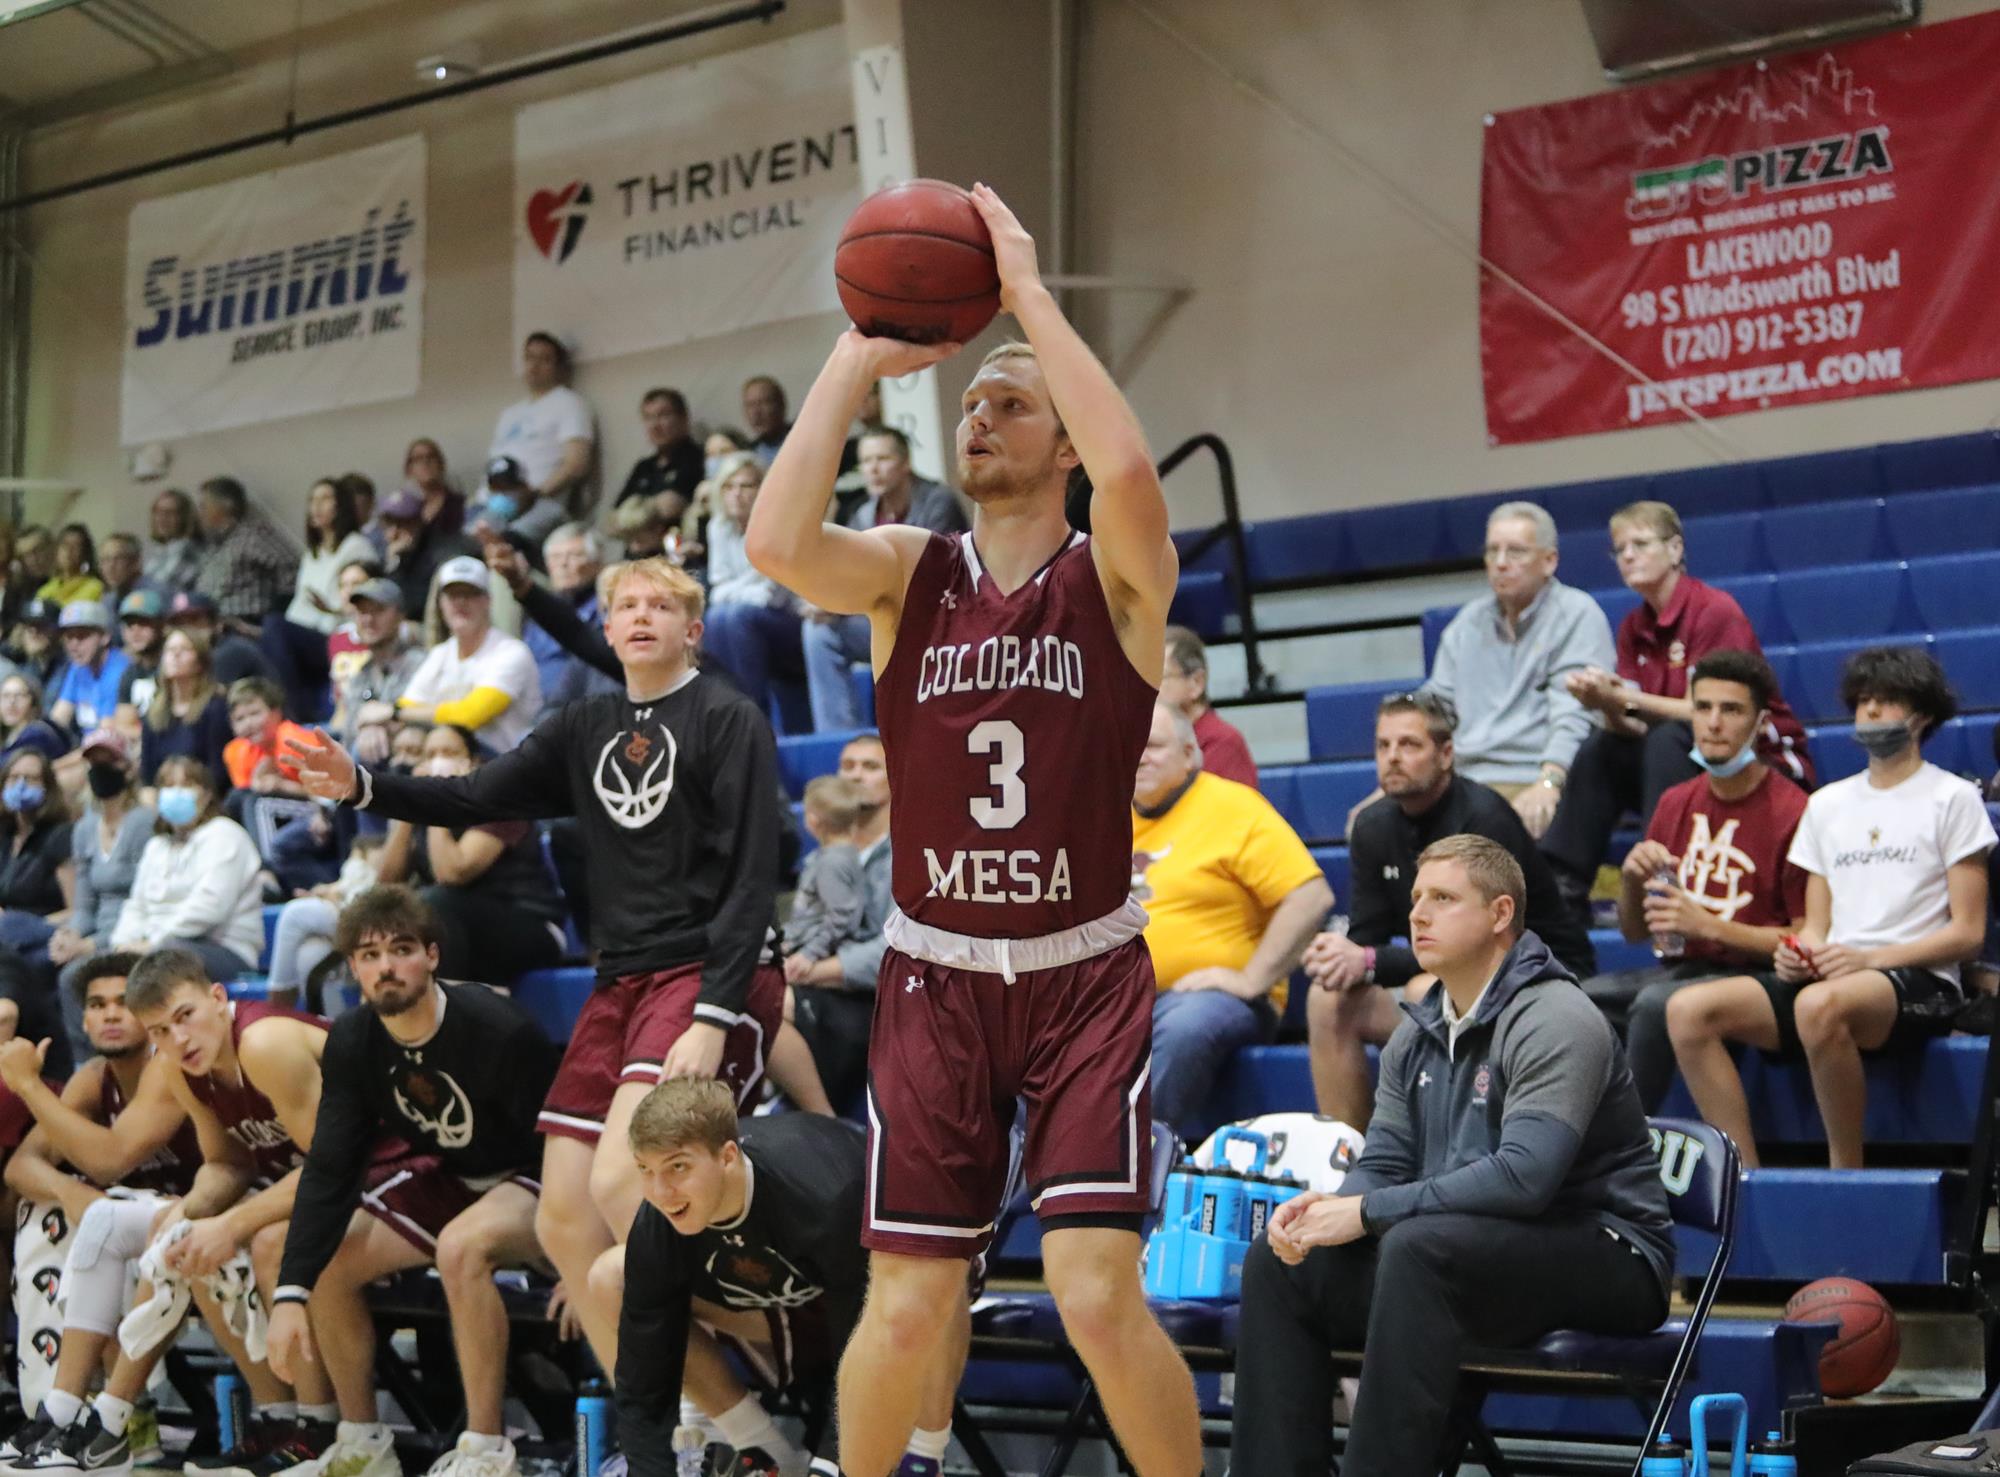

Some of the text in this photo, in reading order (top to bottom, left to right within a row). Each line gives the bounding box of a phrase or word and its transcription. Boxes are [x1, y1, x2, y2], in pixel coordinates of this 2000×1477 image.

[616, 124, 858, 218] THRIVENT
[1732, 128, 1891, 197] PIZZA
[624, 200, 804, 263] FINANCIAL
[1686, 221, 1833, 279] LAKEWOOD
[136, 200, 414, 348] Summit
[1621, 249, 1900, 329] 98 S Wadsworth Blvd
[1662, 300, 1865, 369] (720) 912-5387
[1627, 347, 1903, 422] JETSPIZZA.COM
[916, 635, 1085, 704] COLORADO
[967, 719, 1027, 830] 3
[923, 847, 1073, 904] MESA
